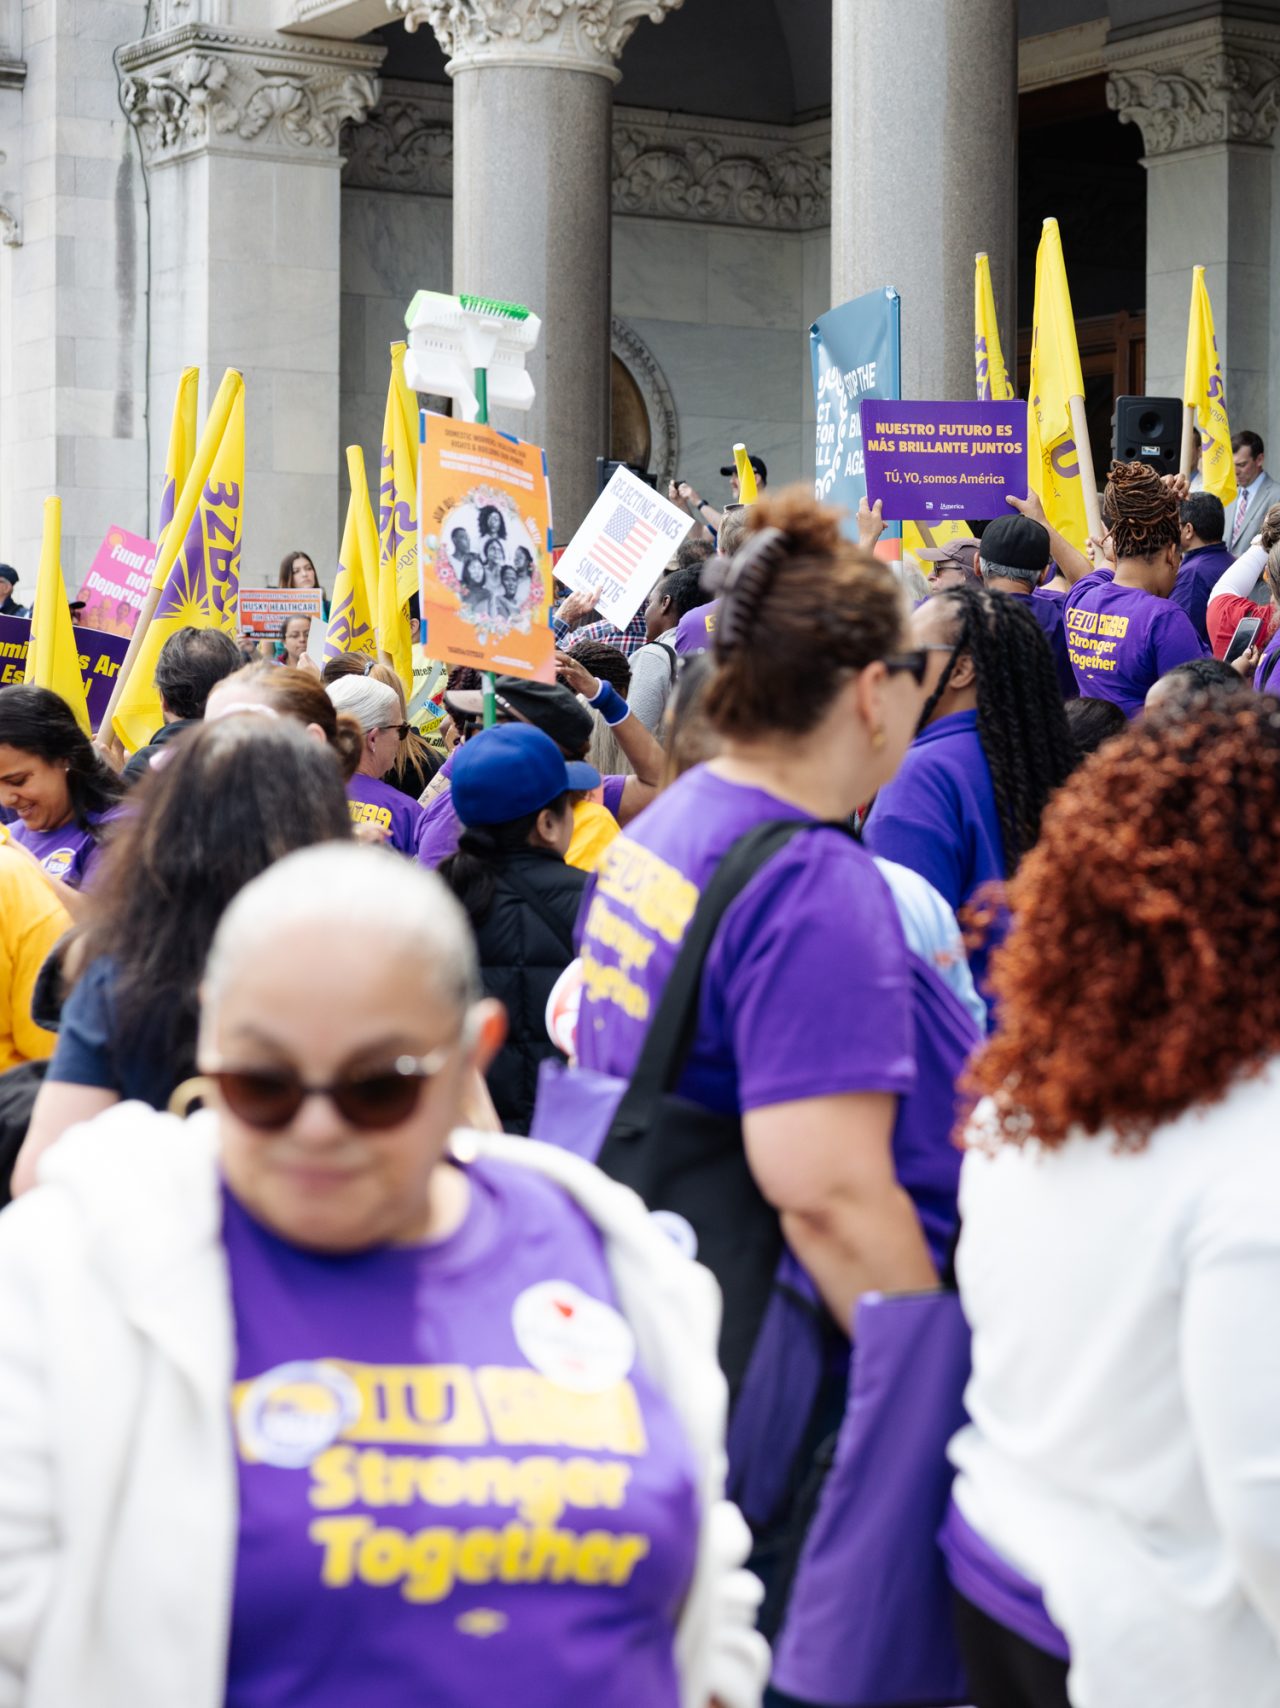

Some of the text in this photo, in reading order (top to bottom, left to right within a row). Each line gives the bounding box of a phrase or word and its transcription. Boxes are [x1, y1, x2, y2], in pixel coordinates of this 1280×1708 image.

[857, 362, 876, 393] THE
[875, 422, 1013, 436] NUESTRO FUTURO ES
[867, 437, 1023, 456] MÁS BRILLANTE JUNTOS
[884, 469, 1005, 485] TÚ, YO, somos América
[610, 477, 684, 540] REJECTING KINGS
[110, 543, 145, 569] Fund
[576, 557, 603, 587] SINCE
[242, 602, 317, 613] HUSKY HEALTHCARE
[1067, 609, 1096, 631] SEIU
[1068, 632, 1116, 653] Stronger
[1068, 649, 1117, 671] Together
[309, 1443, 632, 1527] Stronger
[307, 1513, 651, 1604] Together
